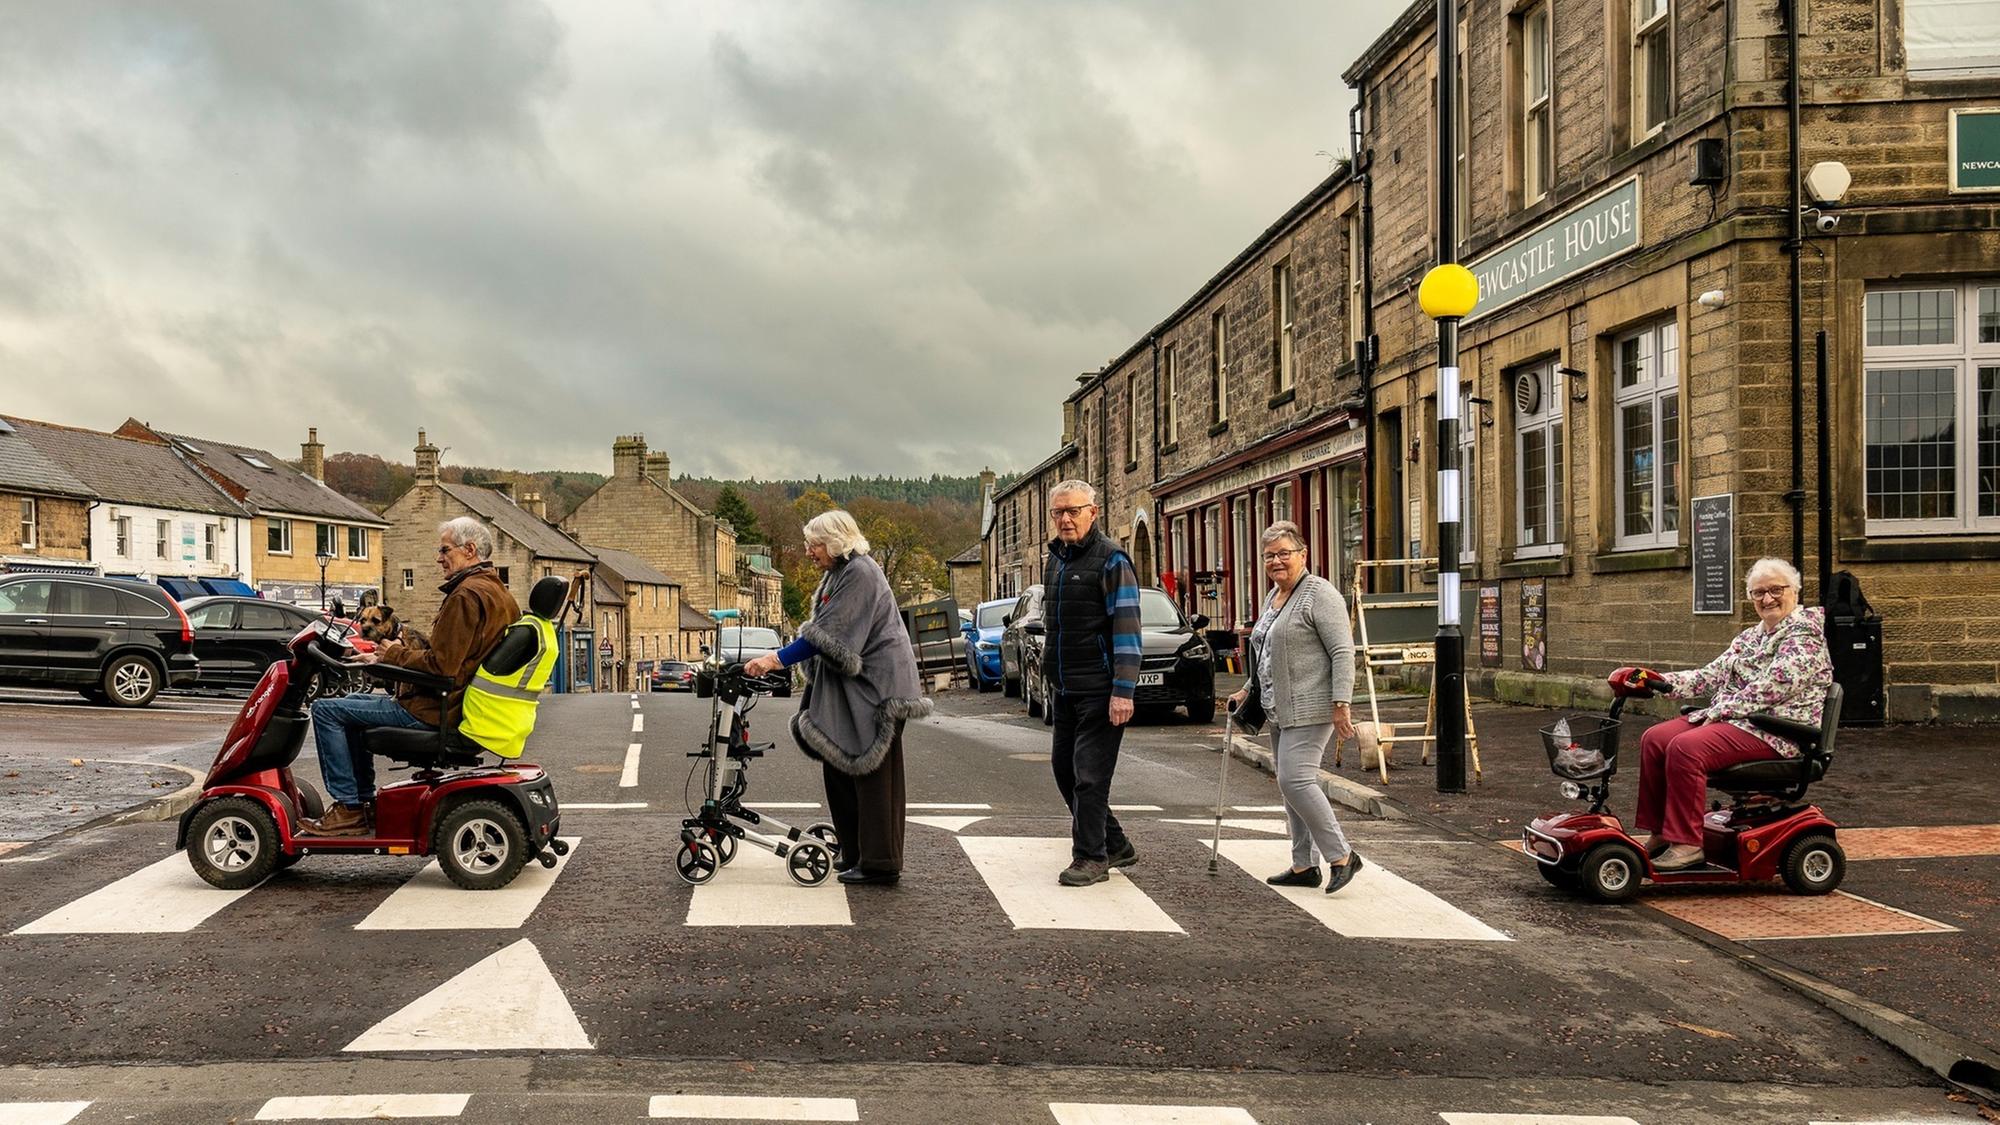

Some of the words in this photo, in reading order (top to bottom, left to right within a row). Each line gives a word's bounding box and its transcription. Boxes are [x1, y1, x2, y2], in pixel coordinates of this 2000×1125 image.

[1475, 238, 1555, 303] EWCASTLE
[1564, 199, 1632, 262] HOUSE
[1301, 442, 1331, 462] HARDWARE
[1141, 674, 1159, 684] VXP
